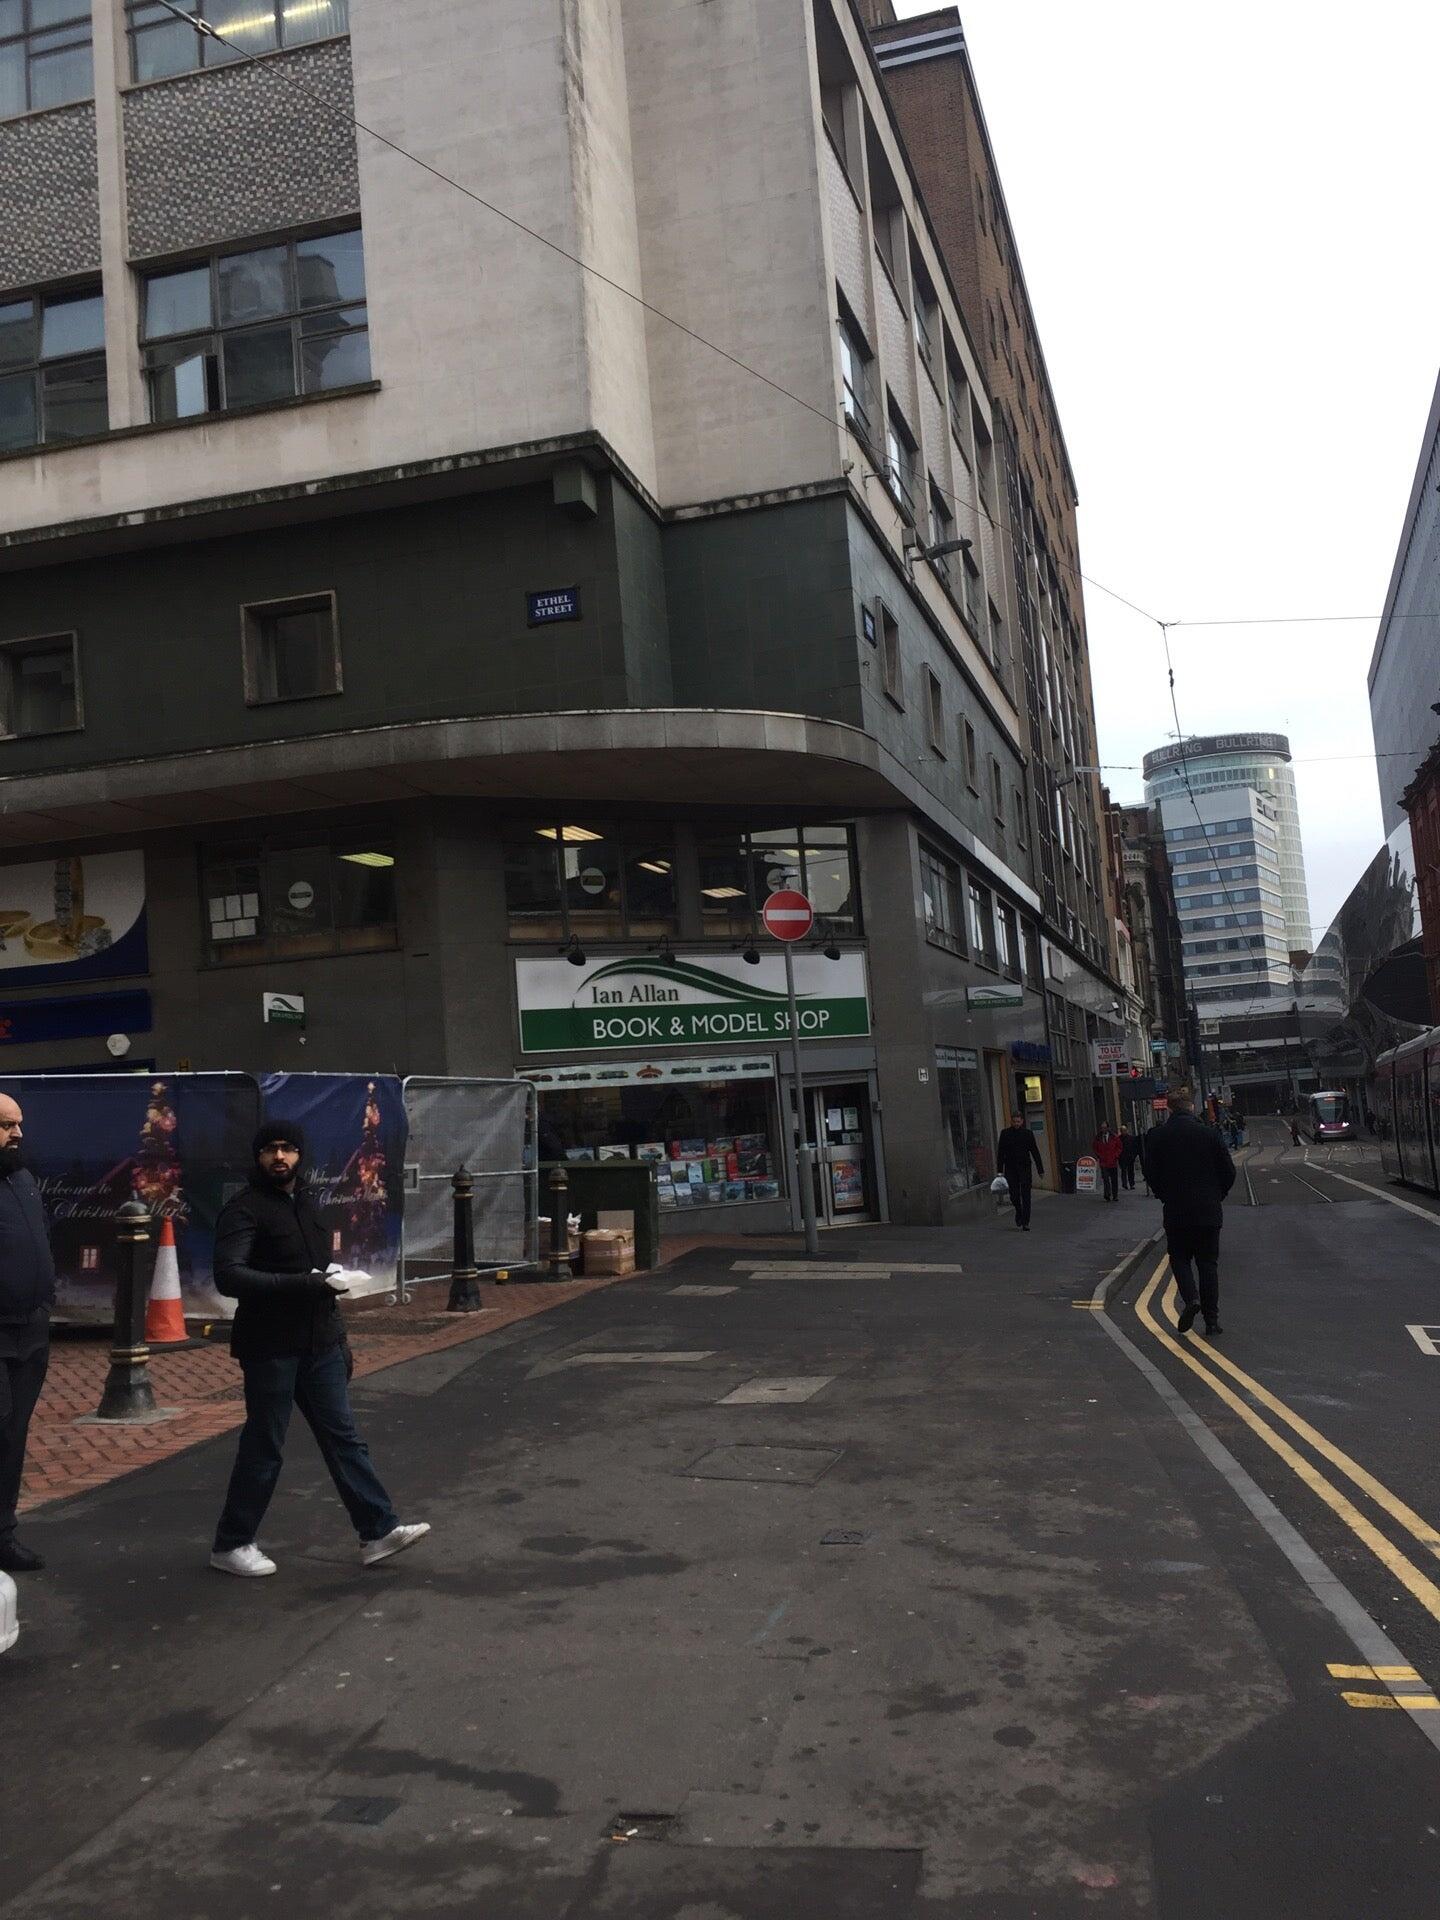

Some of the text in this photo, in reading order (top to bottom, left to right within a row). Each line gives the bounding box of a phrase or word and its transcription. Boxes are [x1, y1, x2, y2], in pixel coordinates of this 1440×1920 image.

[535, 604, 574, 617] STREET
[537, 595, 571, 607] ETHEL
[1152, 736, 1273, 763] BULLRING BULLRING
[592, 985, 679, 1004] Ian Allan
[593, 1017, 663, 1039] BOOK
[670, 1016, 685, 1036] &
[692, 1012, 768, 1034] MODEL
